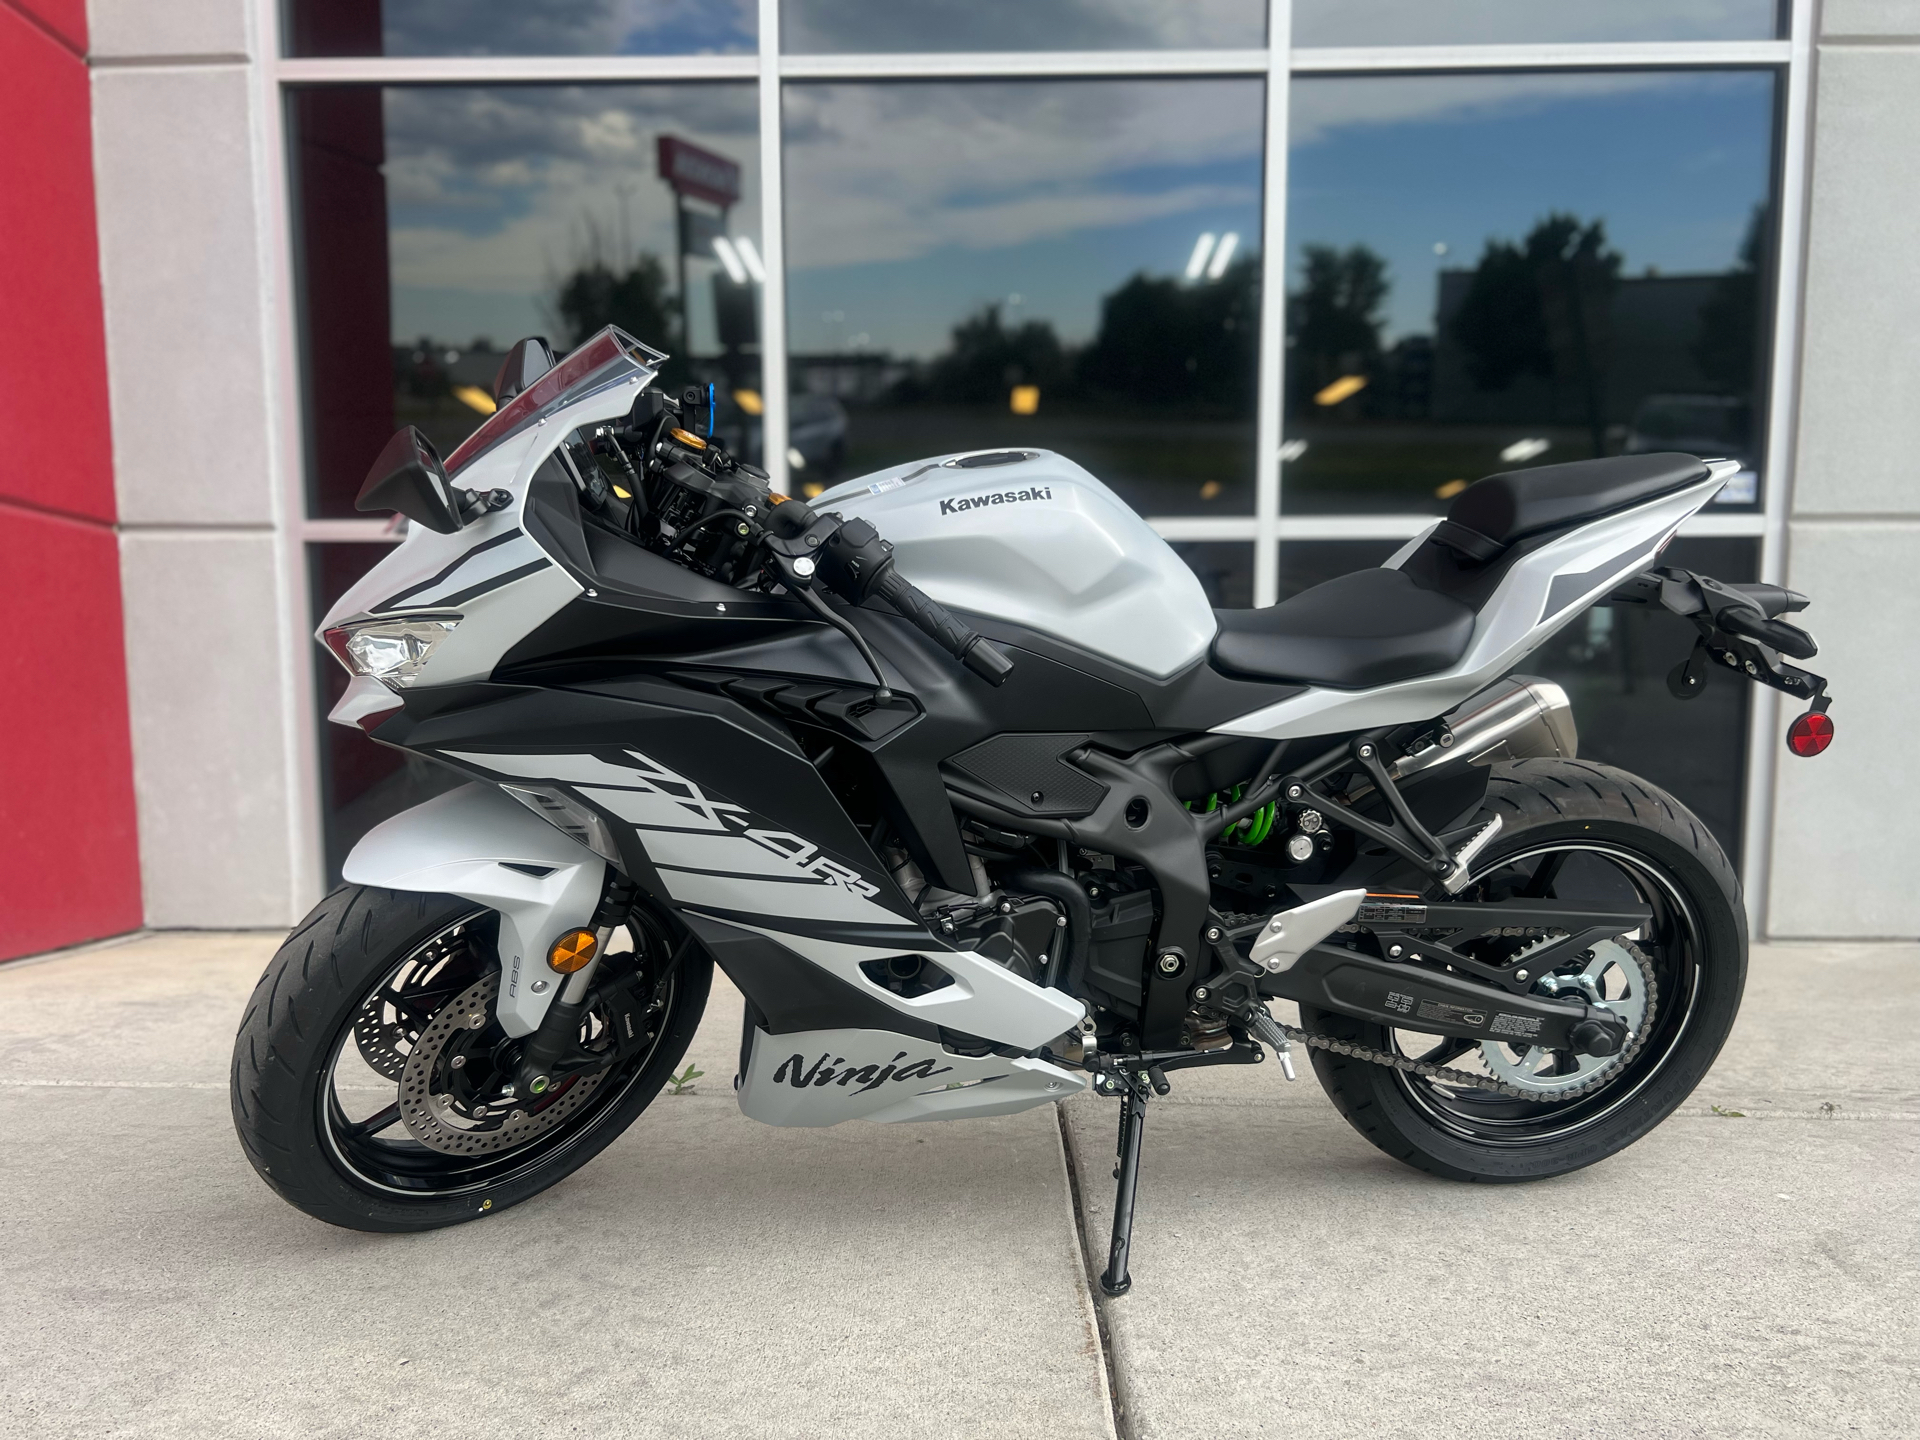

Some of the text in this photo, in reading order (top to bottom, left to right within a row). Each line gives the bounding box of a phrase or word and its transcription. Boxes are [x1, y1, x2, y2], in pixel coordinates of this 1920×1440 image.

[939, 486, 1053, 516] Kawasaki
[509, 954, 521, 999] ABS
[773, 1050, 954, 1097] Ninja
